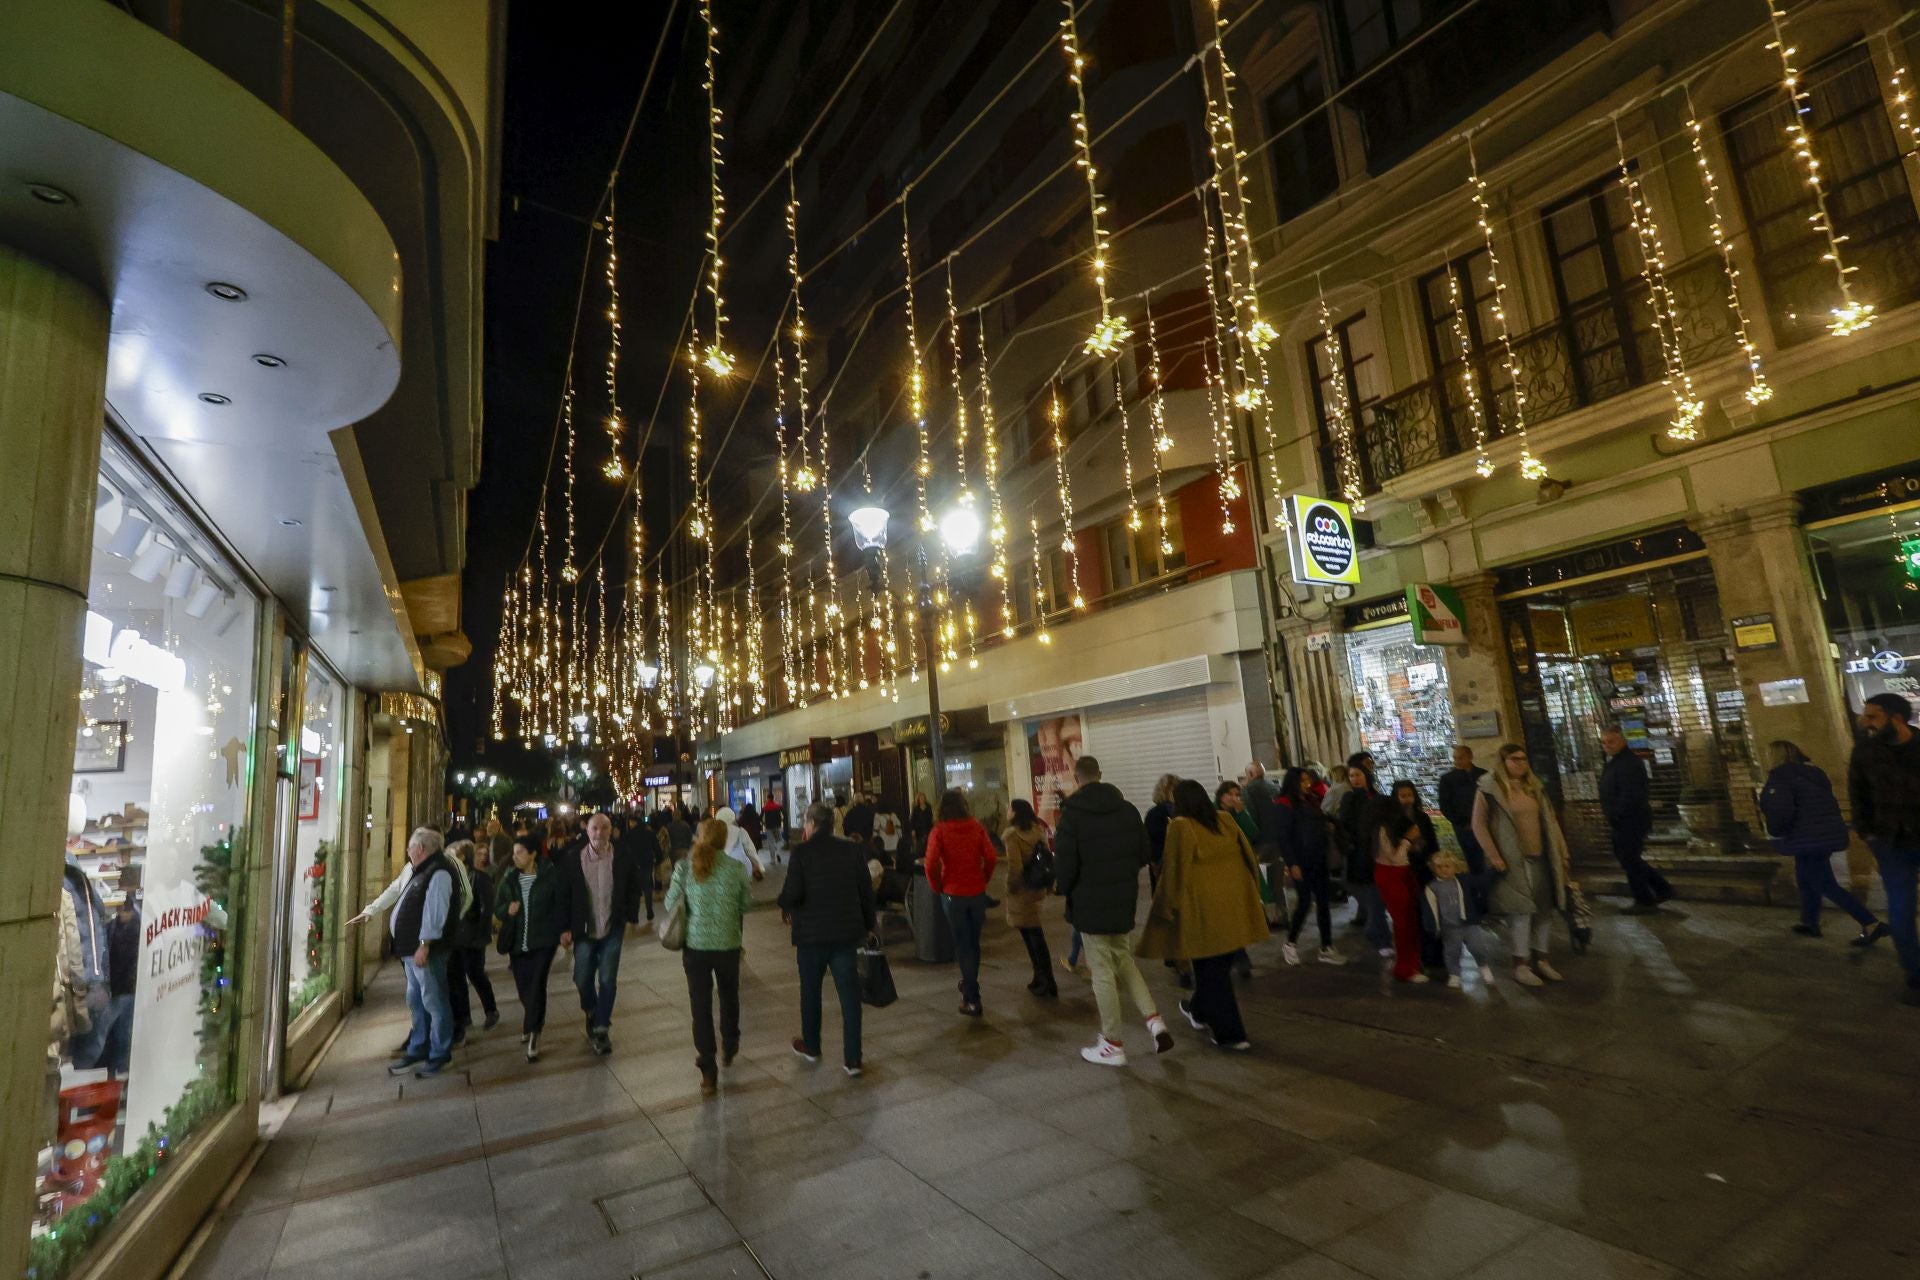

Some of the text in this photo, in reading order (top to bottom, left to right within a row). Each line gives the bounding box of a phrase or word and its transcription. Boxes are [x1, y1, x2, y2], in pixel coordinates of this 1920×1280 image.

[645, 776, 669, 786] TIGER
[146, 895, 211, 947] BLACK FRIDAY
[151, 949, 164, 977] EL
